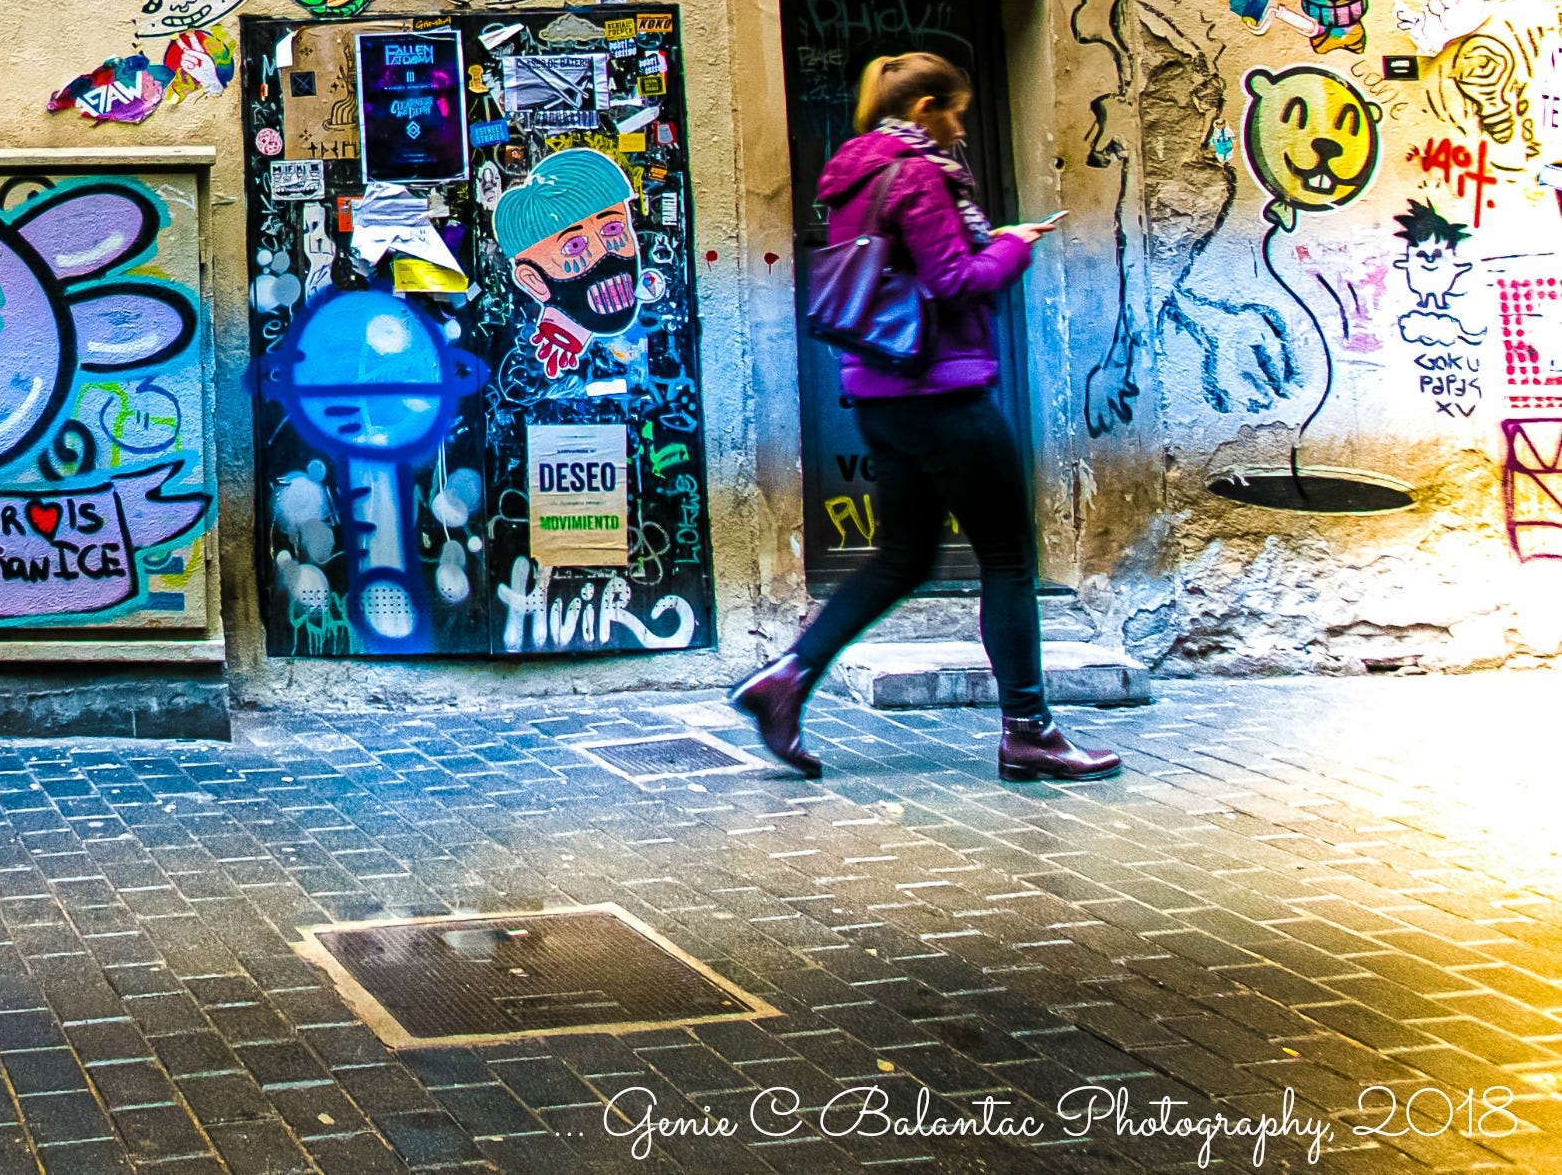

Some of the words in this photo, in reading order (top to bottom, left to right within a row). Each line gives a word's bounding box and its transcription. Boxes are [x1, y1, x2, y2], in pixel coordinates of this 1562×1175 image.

[539, 461, 616, 493] DESEO
[67, 497, 105, 534] IS
[540, 514, 620, 531] MOVIMIENTO
[51, 539, 128, 581] ICE
